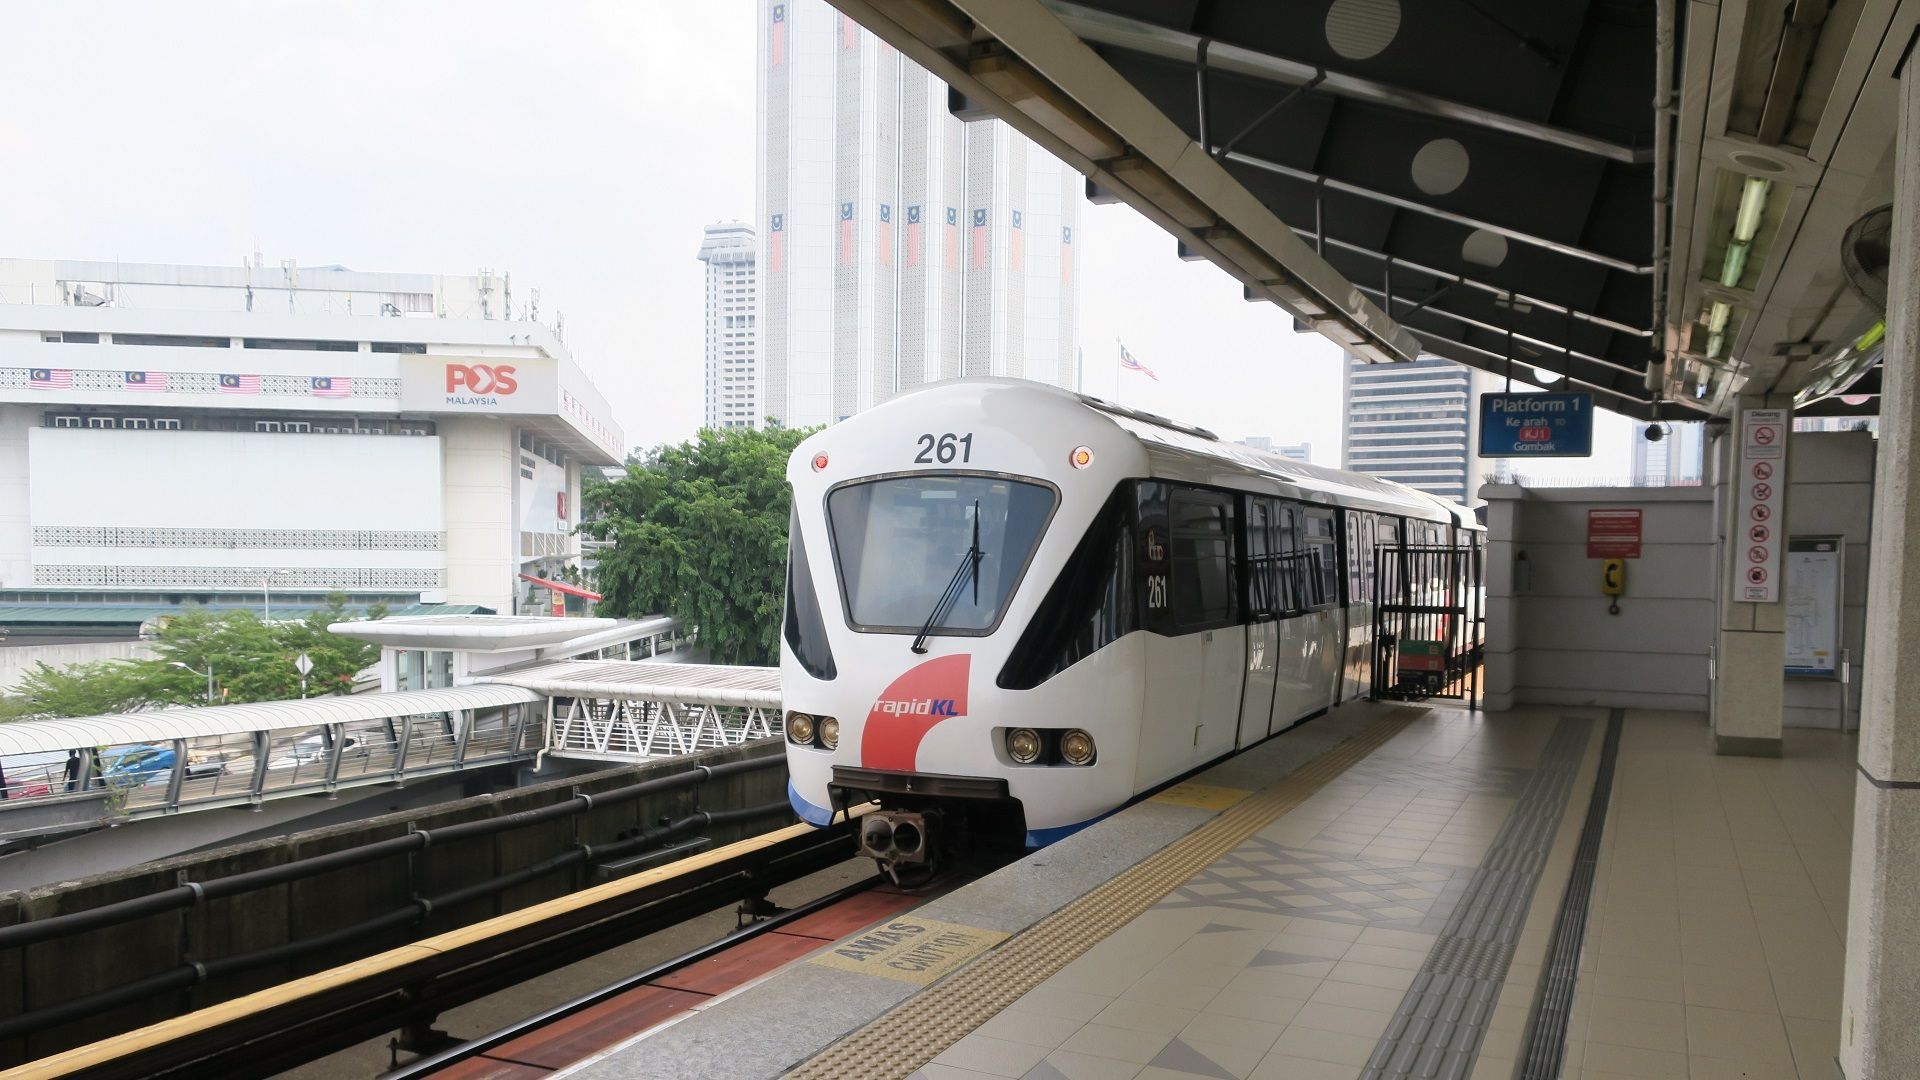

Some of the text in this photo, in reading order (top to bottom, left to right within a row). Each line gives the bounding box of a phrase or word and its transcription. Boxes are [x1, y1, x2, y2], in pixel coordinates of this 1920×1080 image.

[446, 364, 518, 395] POS
[446, 397, 498, 405] MALAYSIA
[1492, 397, 1580, 413] Platform 1
[1506, 417, 1520, 427] Ke
[1523, 417, 1548, 427] arah
[914, 432, 973, 464] 261
[1513, 441, 1555, 451] Gombak
[1148, 575, 1167, 608] 261
[874, 698, 959, 717] rapidKL
[834, 923, 926, 962] AWAS
